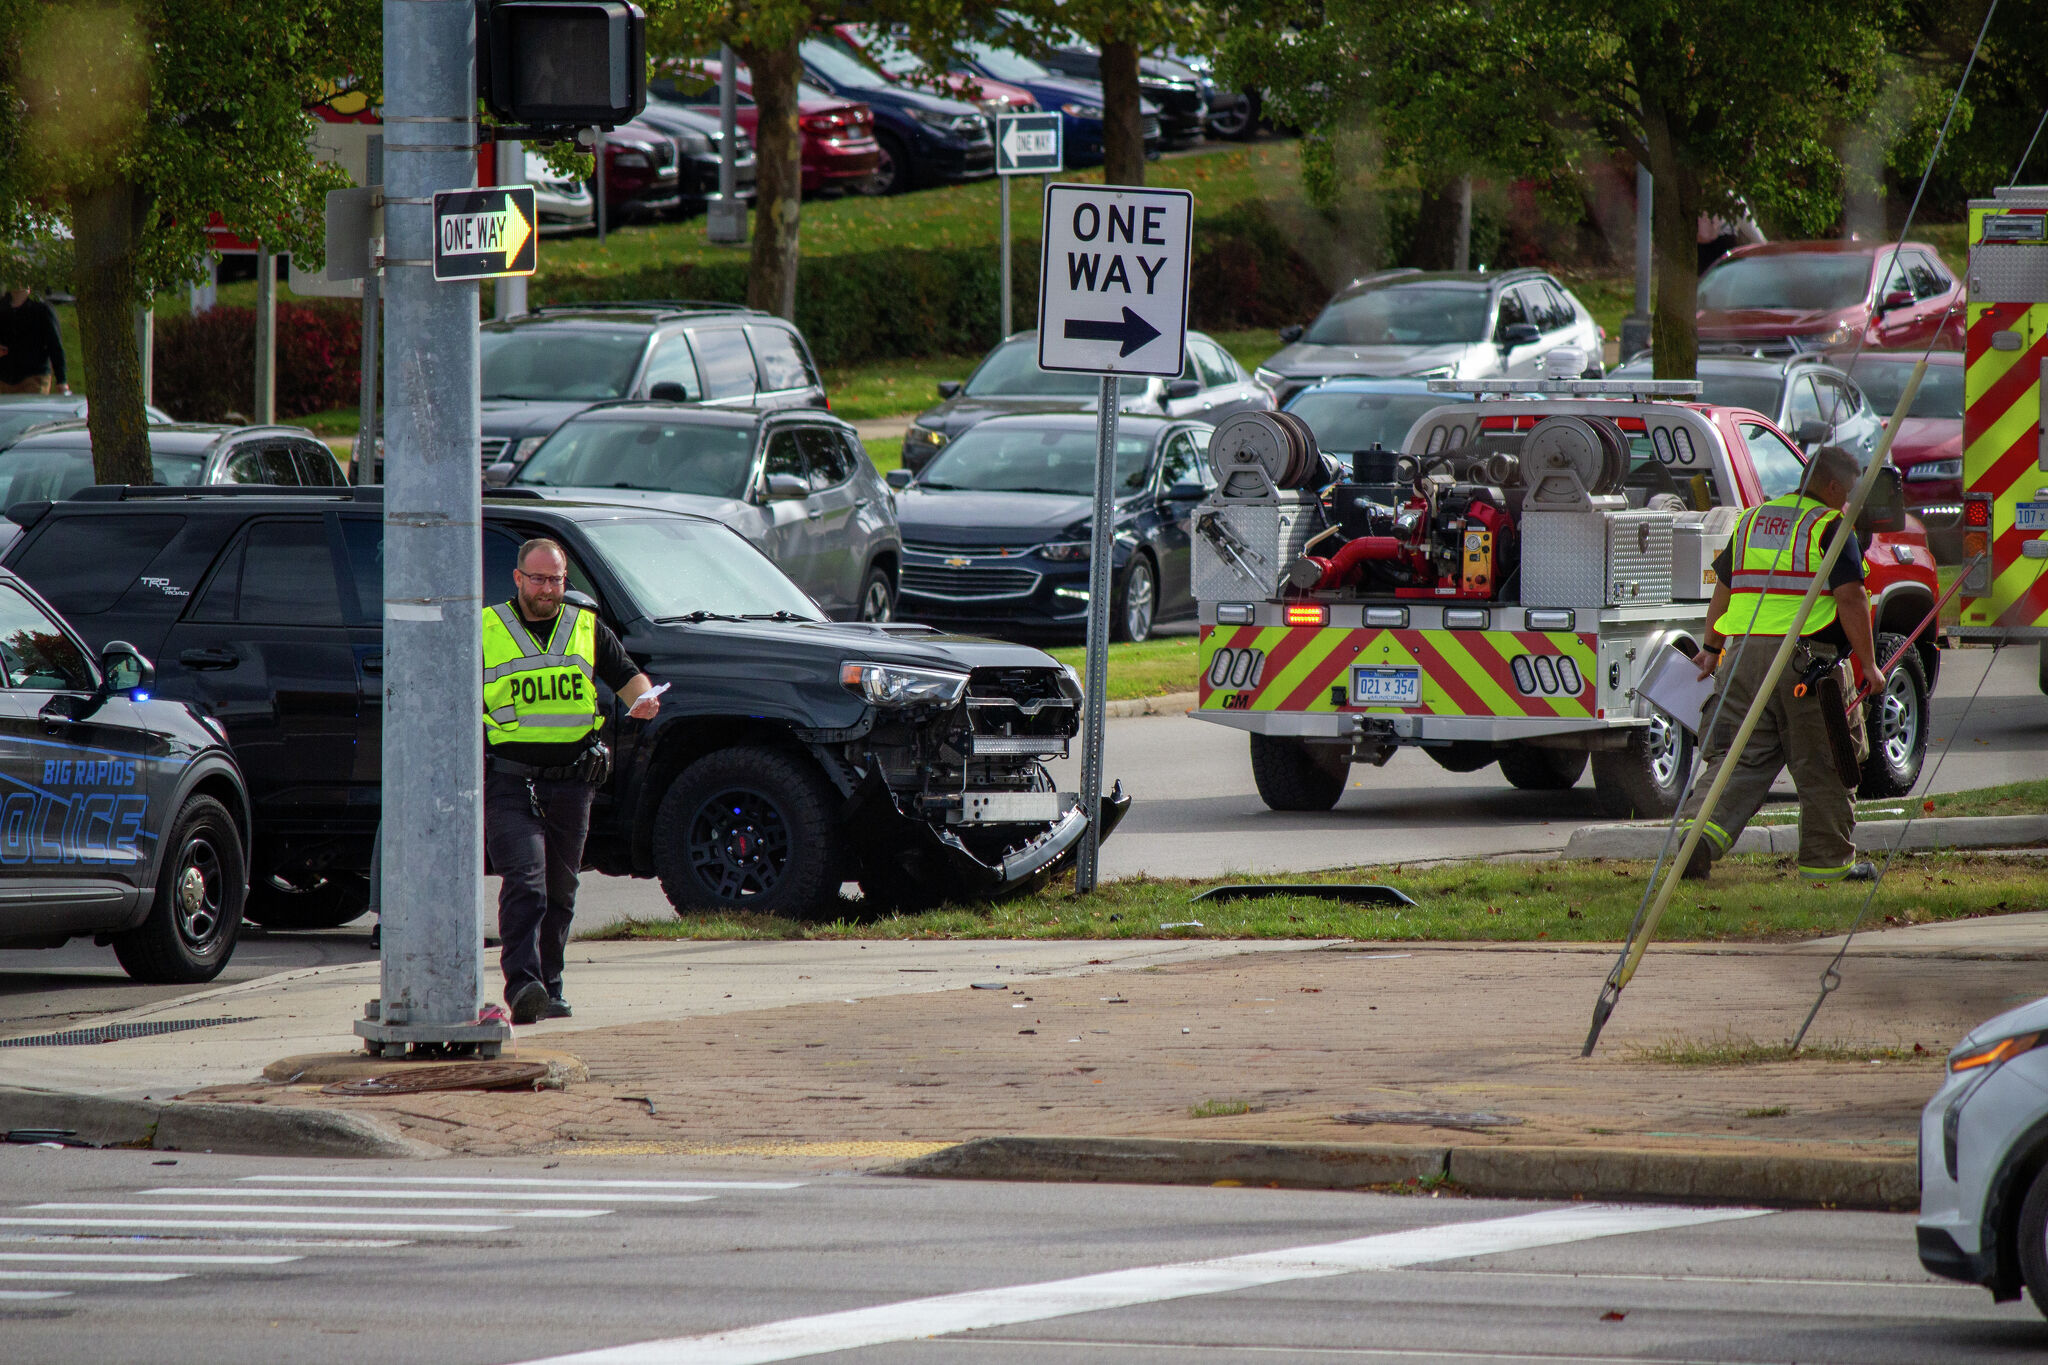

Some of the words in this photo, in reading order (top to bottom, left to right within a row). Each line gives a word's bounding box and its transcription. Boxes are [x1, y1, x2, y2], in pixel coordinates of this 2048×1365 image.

[1017, 134, 1032, 152] ONE
[1034, 133, 1050, 151] WAY
[444, 218, 473, 252] ONE
[477, 215, 506, 249] WAY
[1073, 202, 1166, 245] ONE
[1067, 251, 1168, 295] WAY
[1753, 515, 1791, 536] FIRE
[2018, 510, 2036, 524] 107
[140, 576, 170, 588] TRD
[510, 673, 583, 704] POLICE
[1361, 679, 1380, 695] 021
[1394, 679, 1414, 695] 354
[1222, 694, 1249, 709] CM
[43, 759, 72, 785] BIG
[74, 760, 136, 786] RAPIDS
[0, 792, 149, 865] OLICE
